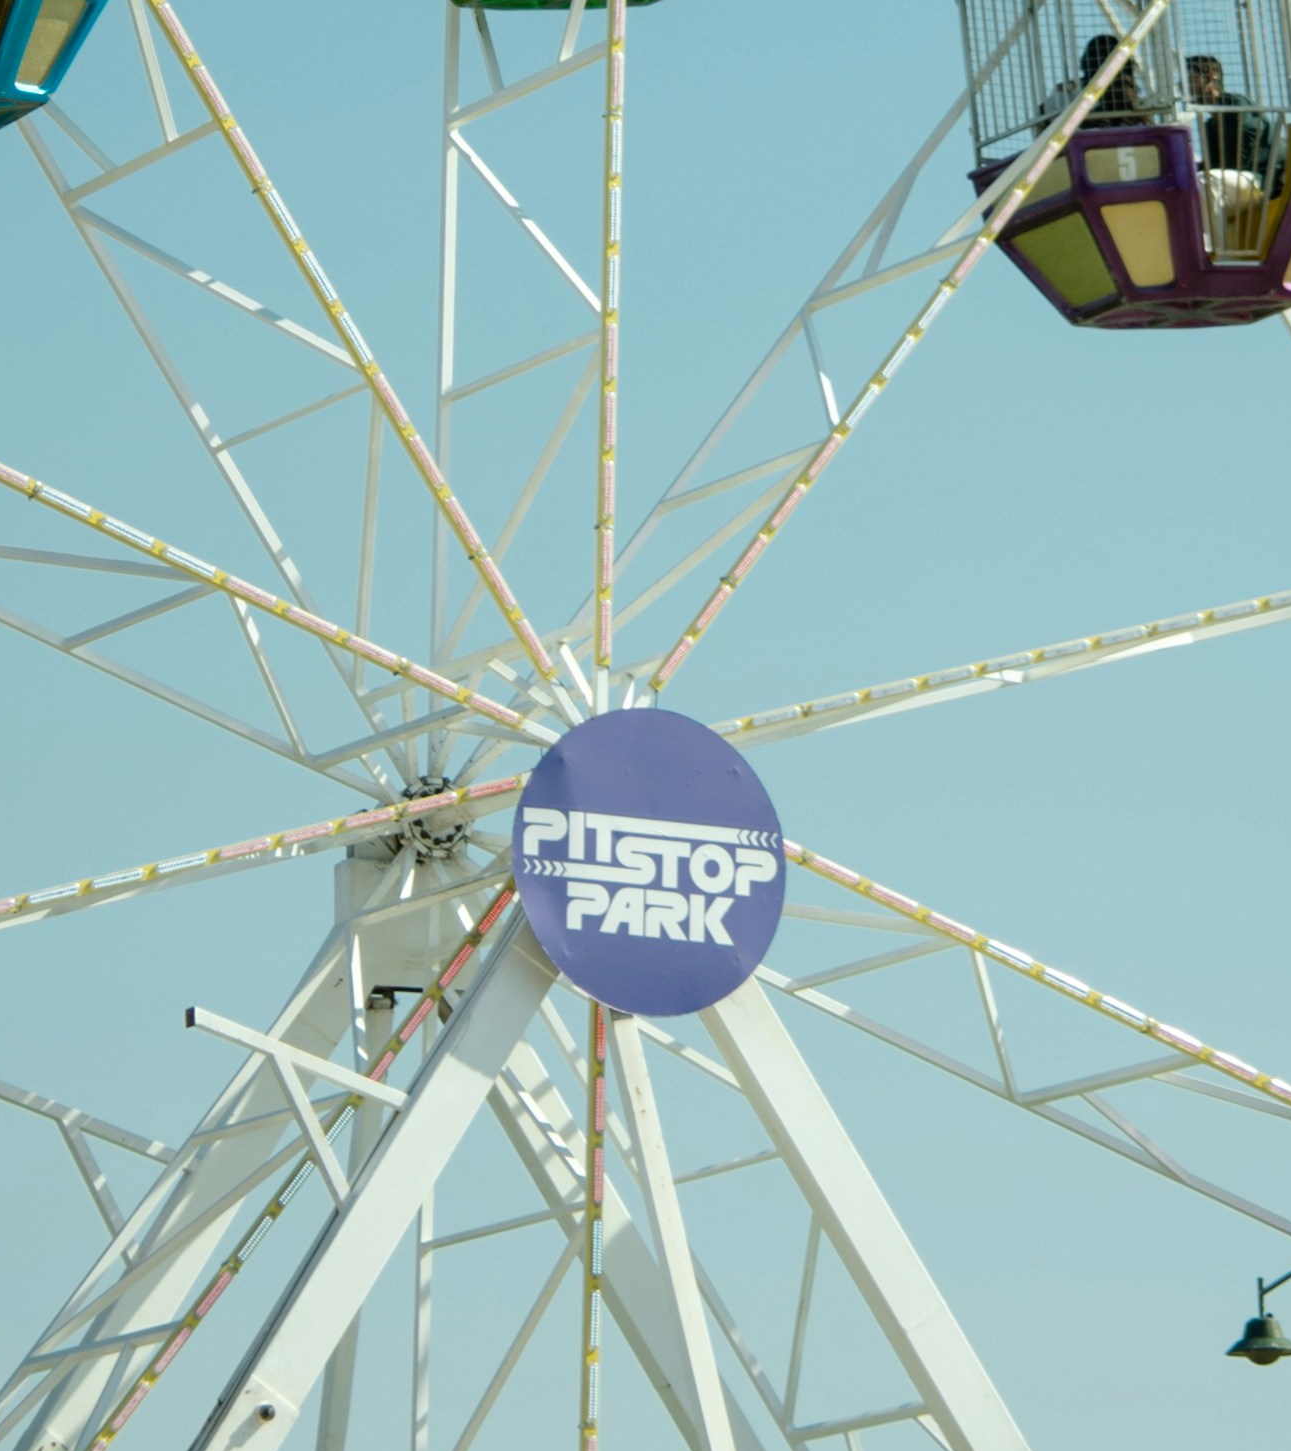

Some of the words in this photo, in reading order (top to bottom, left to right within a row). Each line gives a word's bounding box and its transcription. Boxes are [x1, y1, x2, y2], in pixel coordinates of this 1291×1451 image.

[1117, 146, 1137, 182] 5
[523, 806, 778, 897] PITSTOP
[566, 882, 734, 947] PARK
